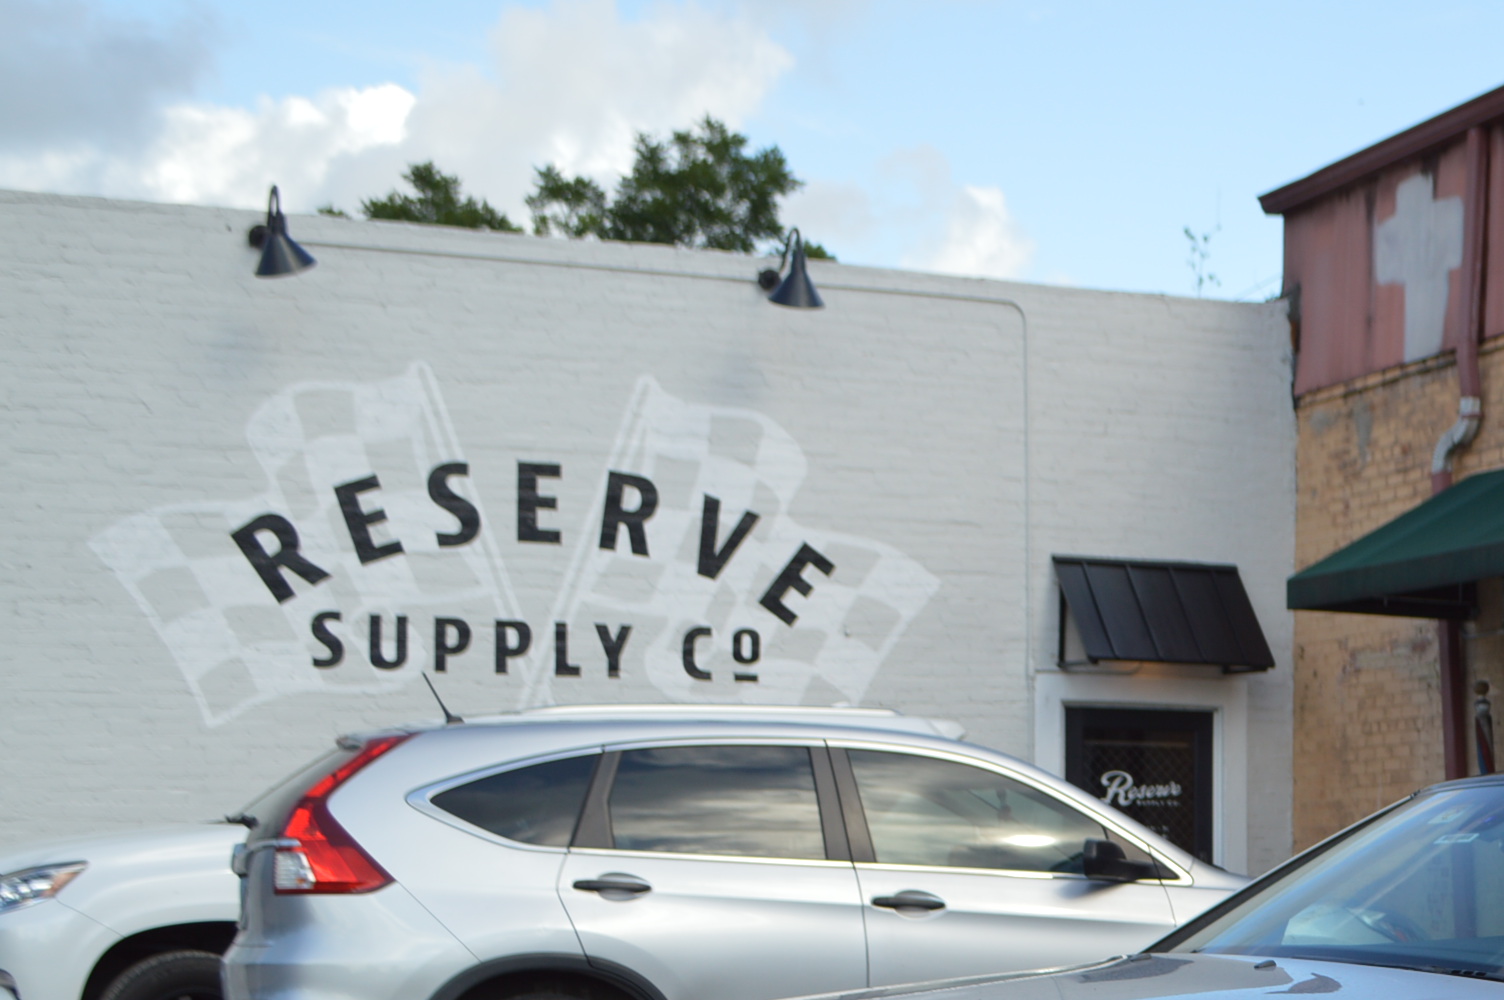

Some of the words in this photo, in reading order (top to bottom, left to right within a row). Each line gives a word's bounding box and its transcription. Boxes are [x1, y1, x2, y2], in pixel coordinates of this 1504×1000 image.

[231, 462, 835, 625] RESERVE
[311, 611, 631, 678] SUPPLY
[1100, 769, 1182, 807] Reserve
